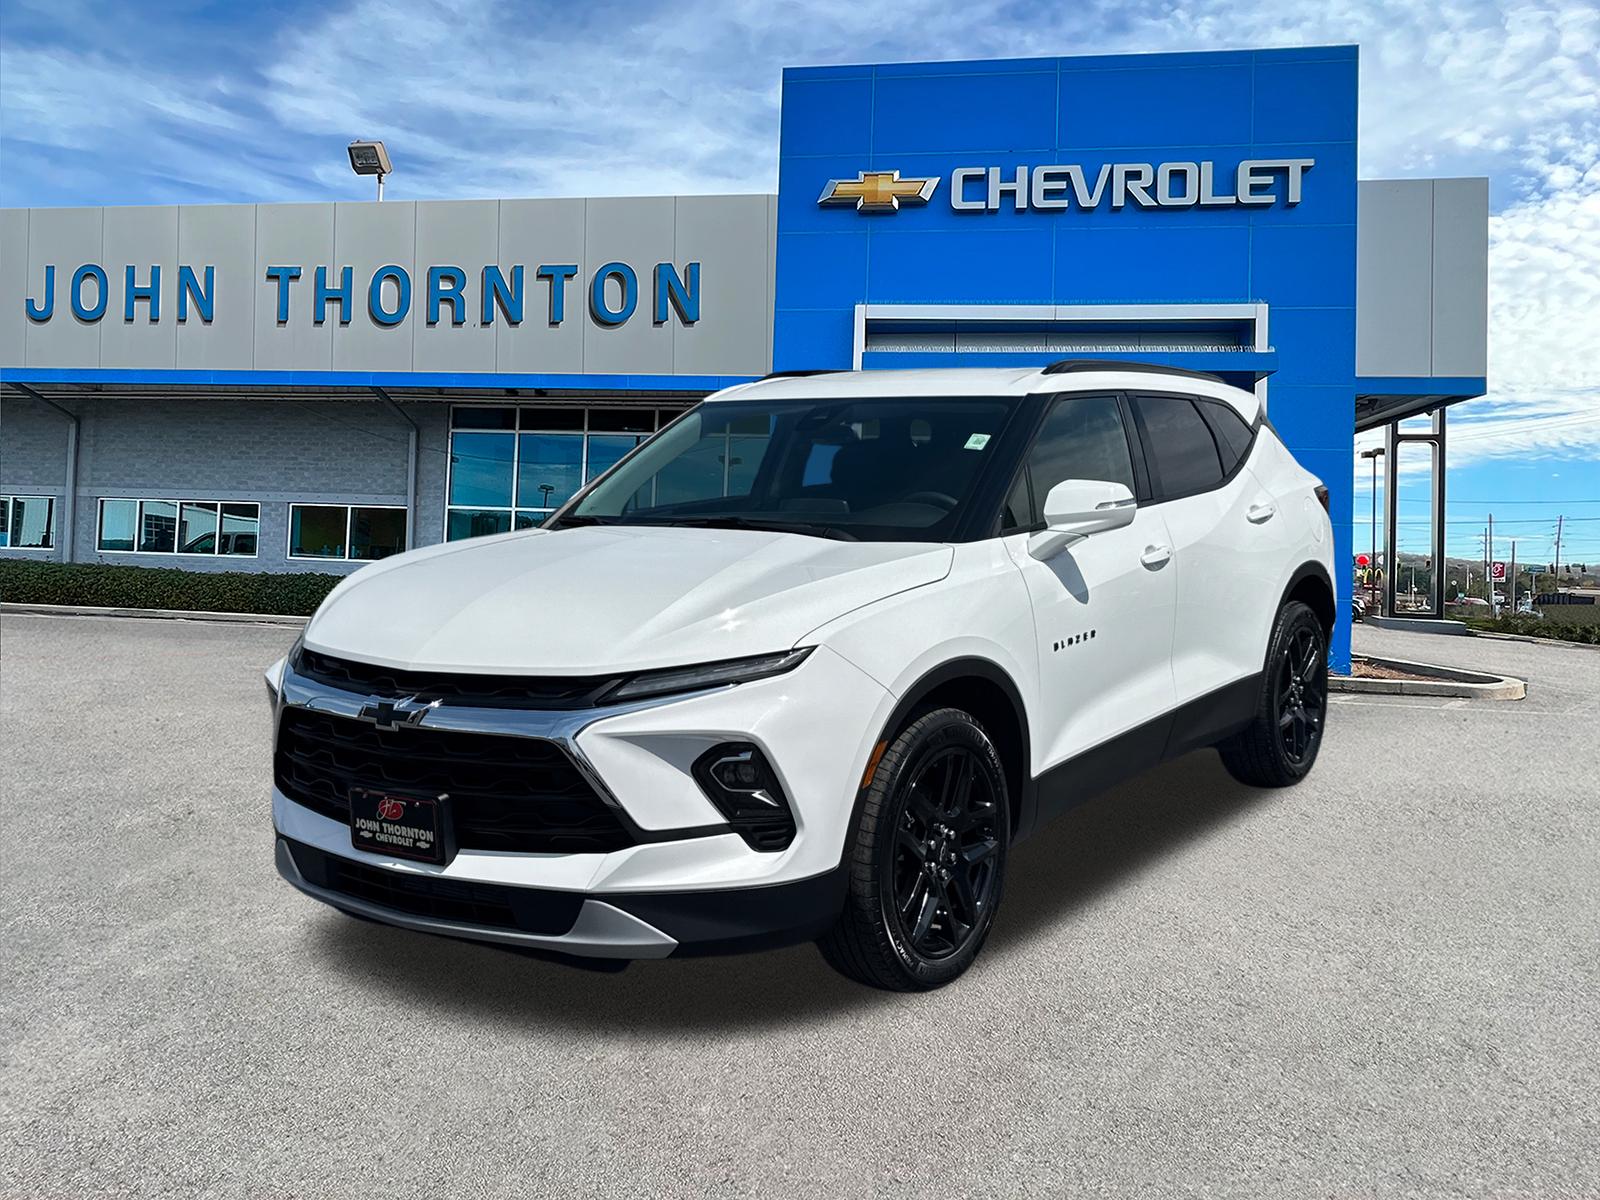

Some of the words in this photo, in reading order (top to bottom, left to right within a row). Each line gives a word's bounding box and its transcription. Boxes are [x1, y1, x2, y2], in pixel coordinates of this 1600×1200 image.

[950, 158, 1315, 213] CHEVROLET
[25, 263, 216, 325] JOHN
[266, 261, 702, 328] THORNTON
[1053, 629, 1096, 652] BLAZER
[355, 818, 380, 831] JOHN
[382, 823, 434, 842] THORNTON
[375, 832, 414, 847] CHEVROLET
